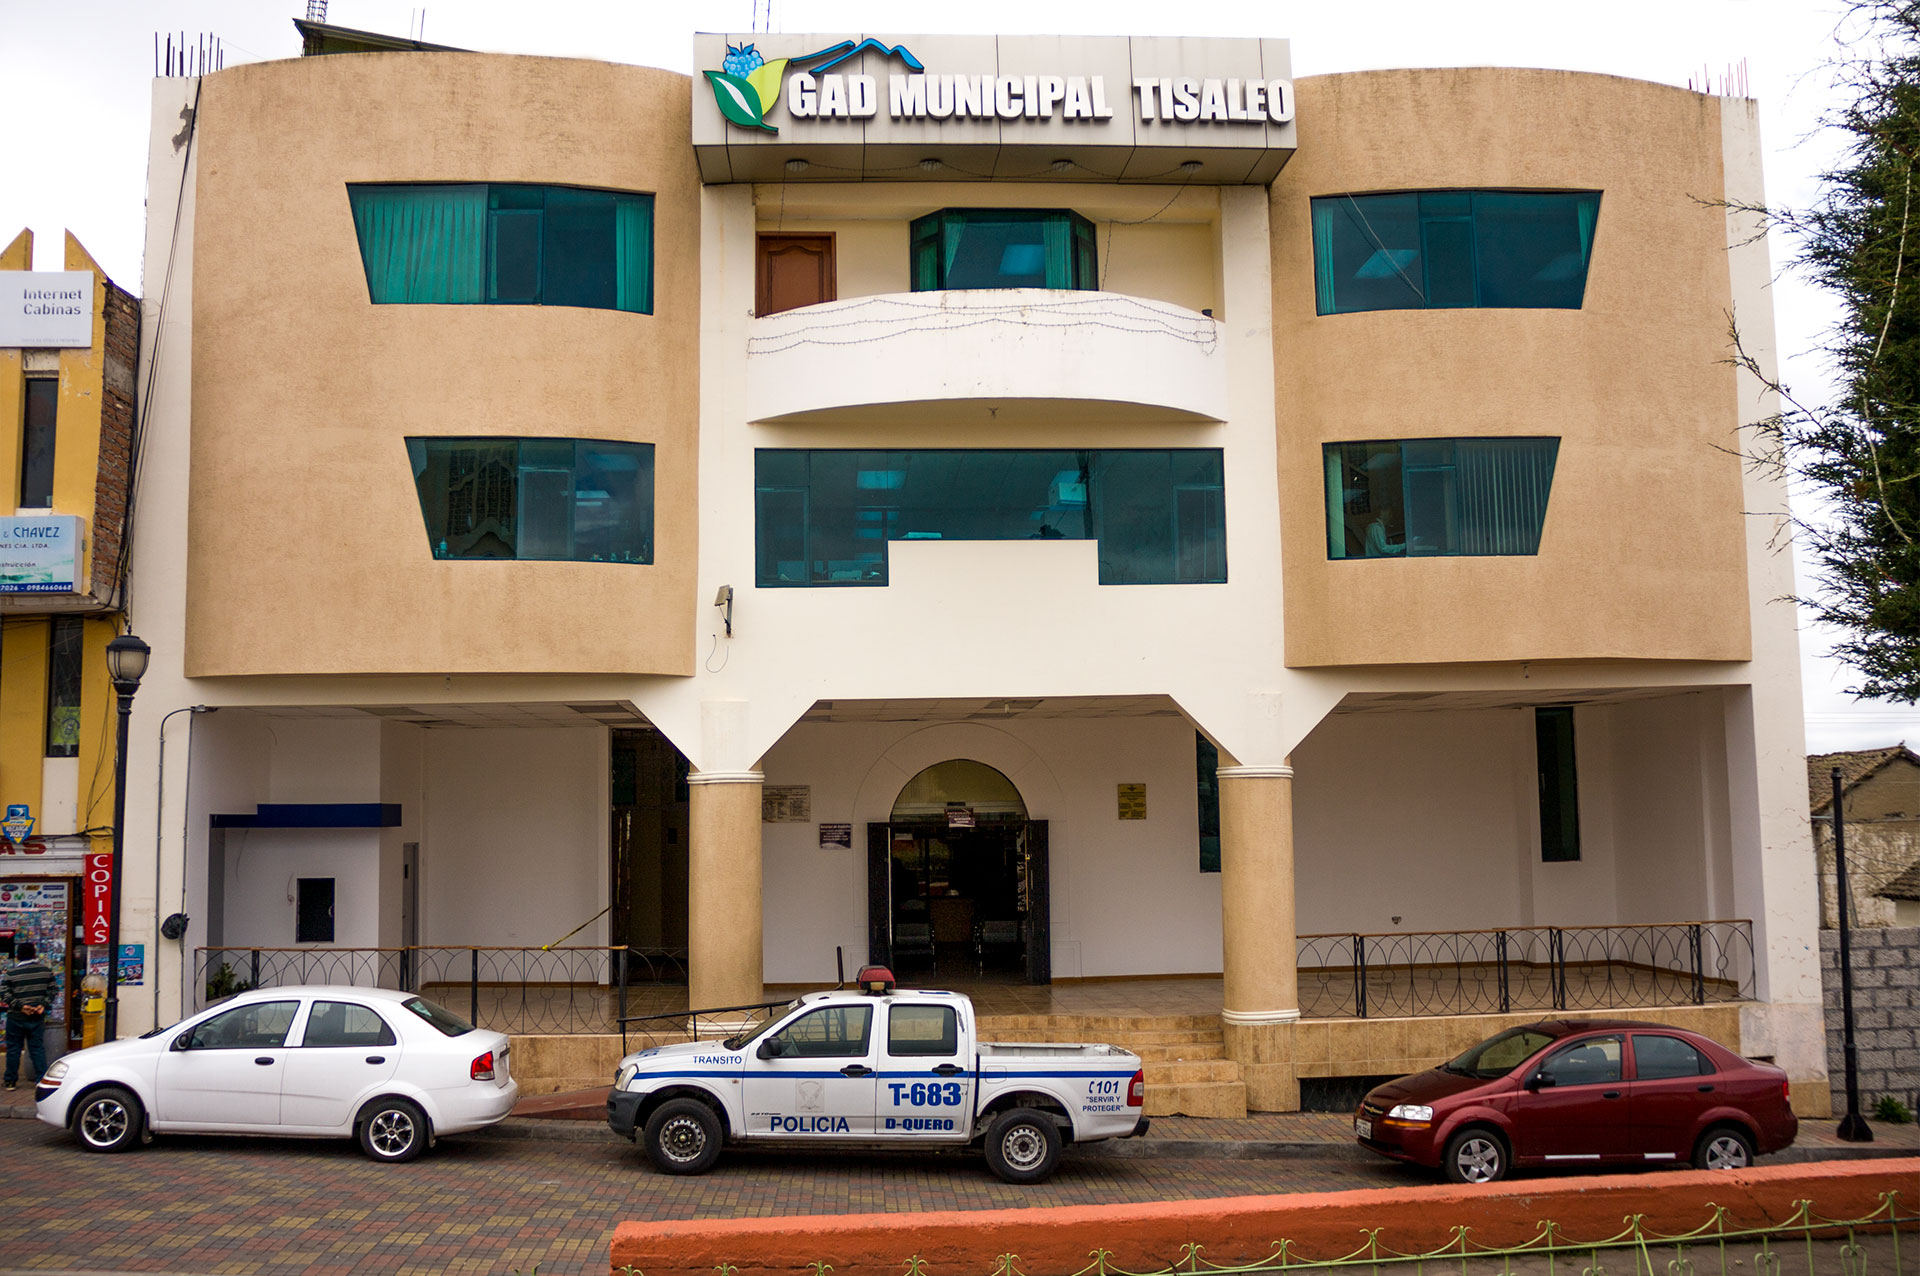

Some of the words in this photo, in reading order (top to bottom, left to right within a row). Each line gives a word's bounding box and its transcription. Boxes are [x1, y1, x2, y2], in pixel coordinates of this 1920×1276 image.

[787, 72, 878, 121] GAD
[889, 72, 1114, 123] MUNICIPAL
[1132, 77, 1296, 126] TISALEO
[23, 288, 82, 300] Internet
[23, 303, 81, 315] Cabinas
[13, 526, 60, 538] CHAVEZ
[91, 854, 111, 943] COPIAS
[693, 1055, 743, 1065] TRANSITO
[888, 1082, 962, 1107] T-683
[770, 1116, 850, 1133] POLICIA
[885, 1117, 954, 1131] D-QUERO
